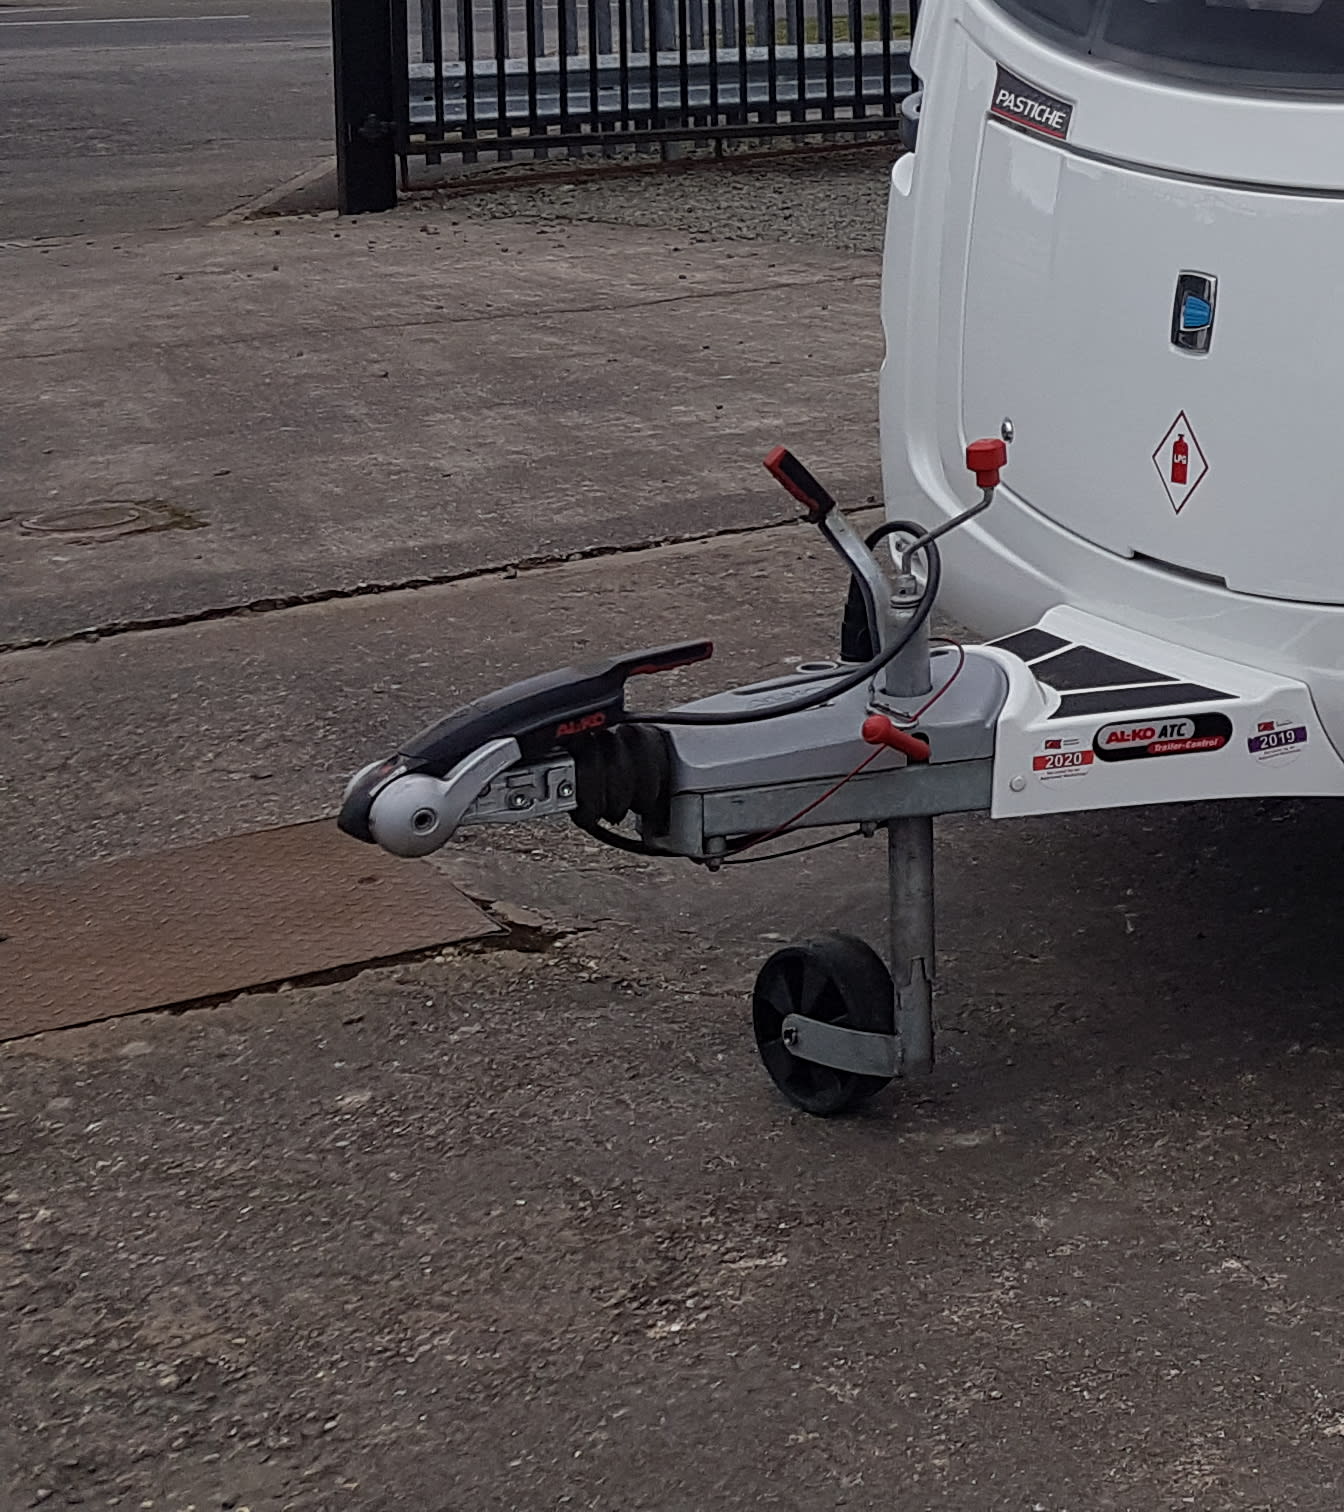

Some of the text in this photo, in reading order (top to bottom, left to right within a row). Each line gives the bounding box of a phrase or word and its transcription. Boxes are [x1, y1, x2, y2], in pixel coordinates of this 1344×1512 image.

[996, 89, 1066, 128] PASTICHE
[1174, 454, 1187, 464] LPG
[1105, 723, 1188, 745] AL-KO ATC
[1260, 730, 1296, 749] 2019
[1154, 738, 1219, 752] Trailer-Control
[1045, 752, 1082, 768] 2020
